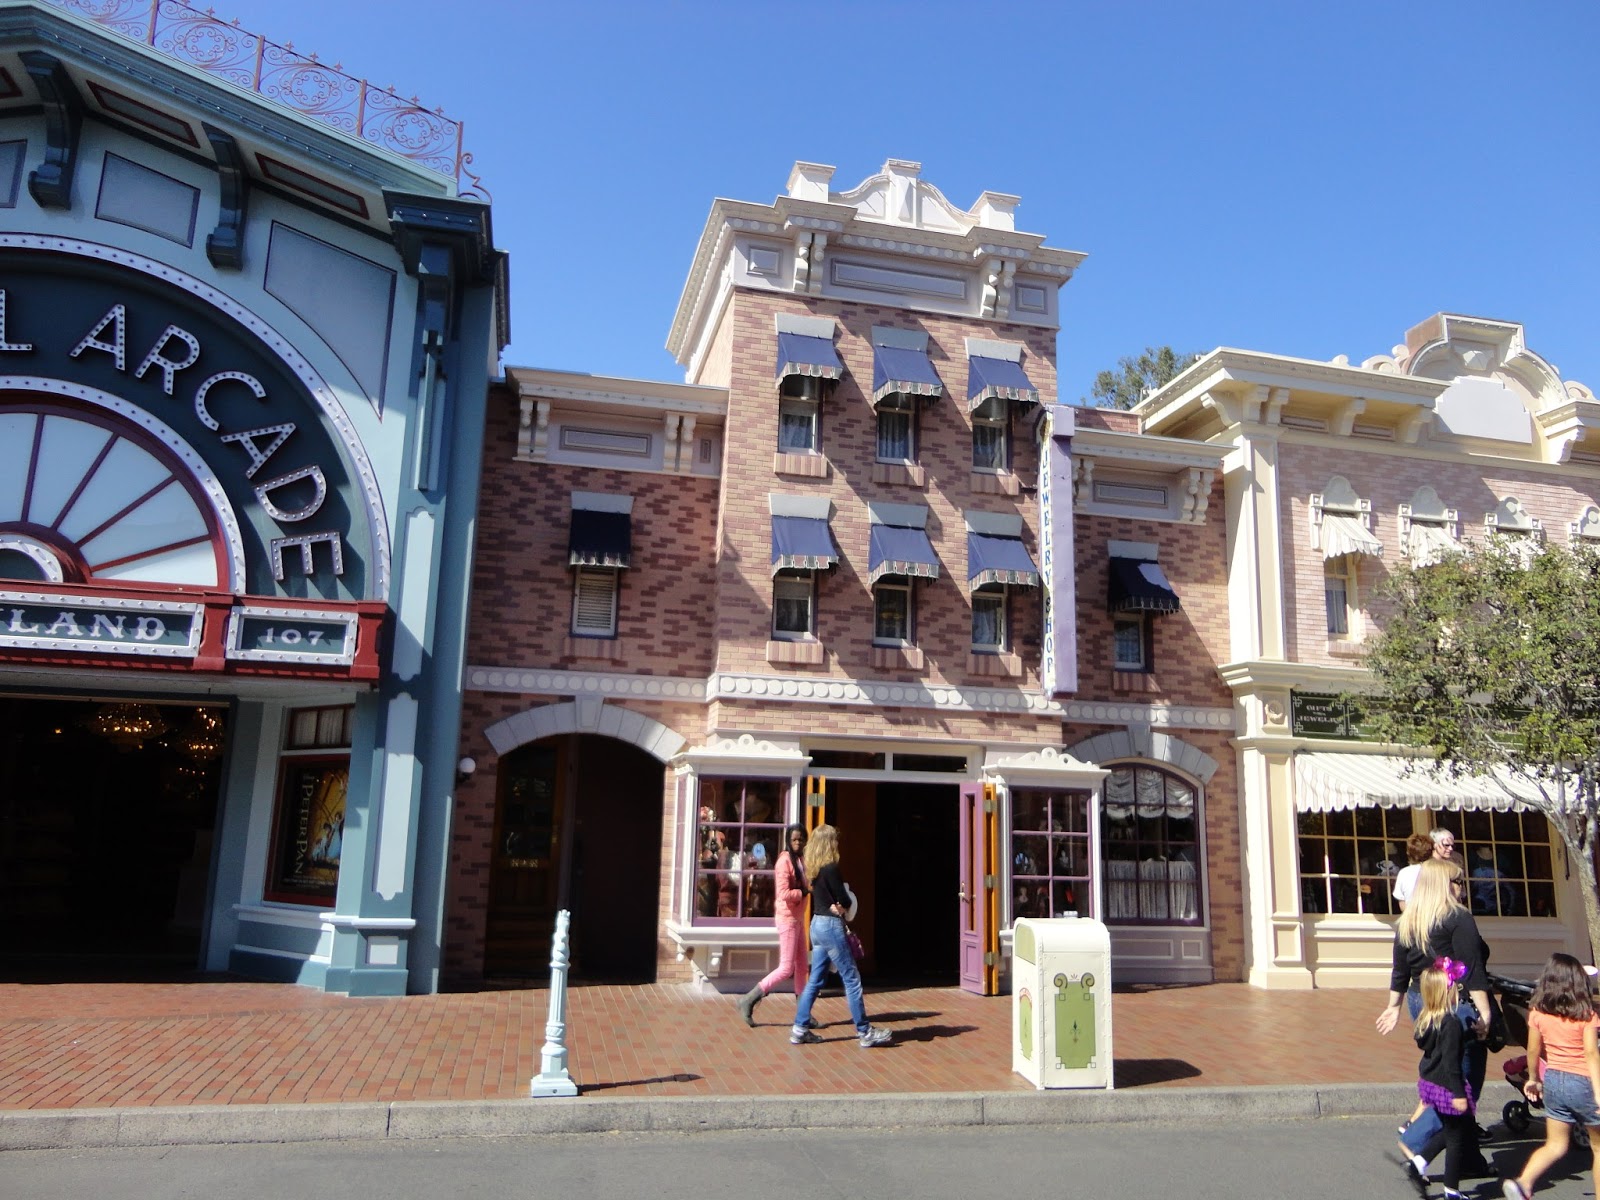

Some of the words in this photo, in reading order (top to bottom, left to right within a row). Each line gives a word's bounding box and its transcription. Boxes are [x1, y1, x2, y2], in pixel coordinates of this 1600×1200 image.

[69, 303, 344, 582] ARCADE
[1042, 450, 1051, 586] JEWELRY
[0, 608, 166, 641] LAND
[265, 627, 325, 646] 107
[1045, 596, 1054, 674] SHOP
[297, 784, 314, 840] PETER
[294, 841, 308, 874] PAN
